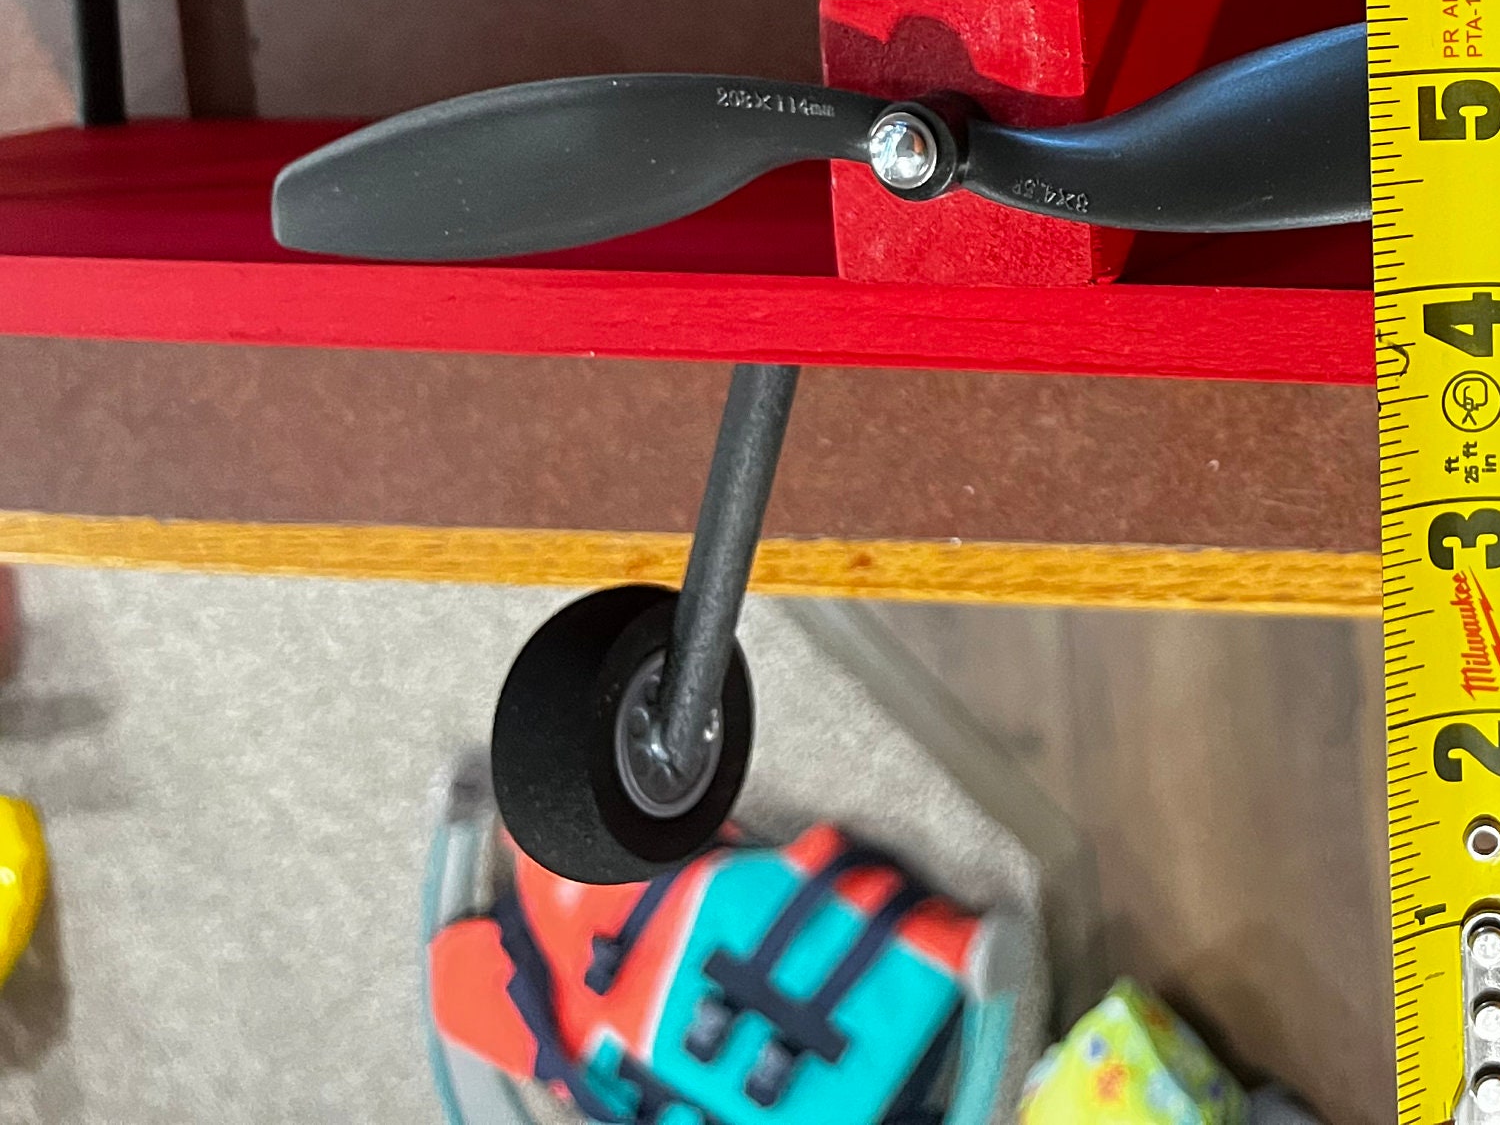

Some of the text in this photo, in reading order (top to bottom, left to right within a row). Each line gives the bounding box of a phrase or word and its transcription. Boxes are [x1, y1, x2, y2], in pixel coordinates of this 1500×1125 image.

[1443, 28, 1459, 58] PR
[1444, 456, 1460, 474] ft
[1462, 441, 1480, 484] 25 ft
[1482, 454, 1497, 473] in
[1450, 570, 1500, 700] Milwaukee
[1414, 903, 1447, 926] 1
